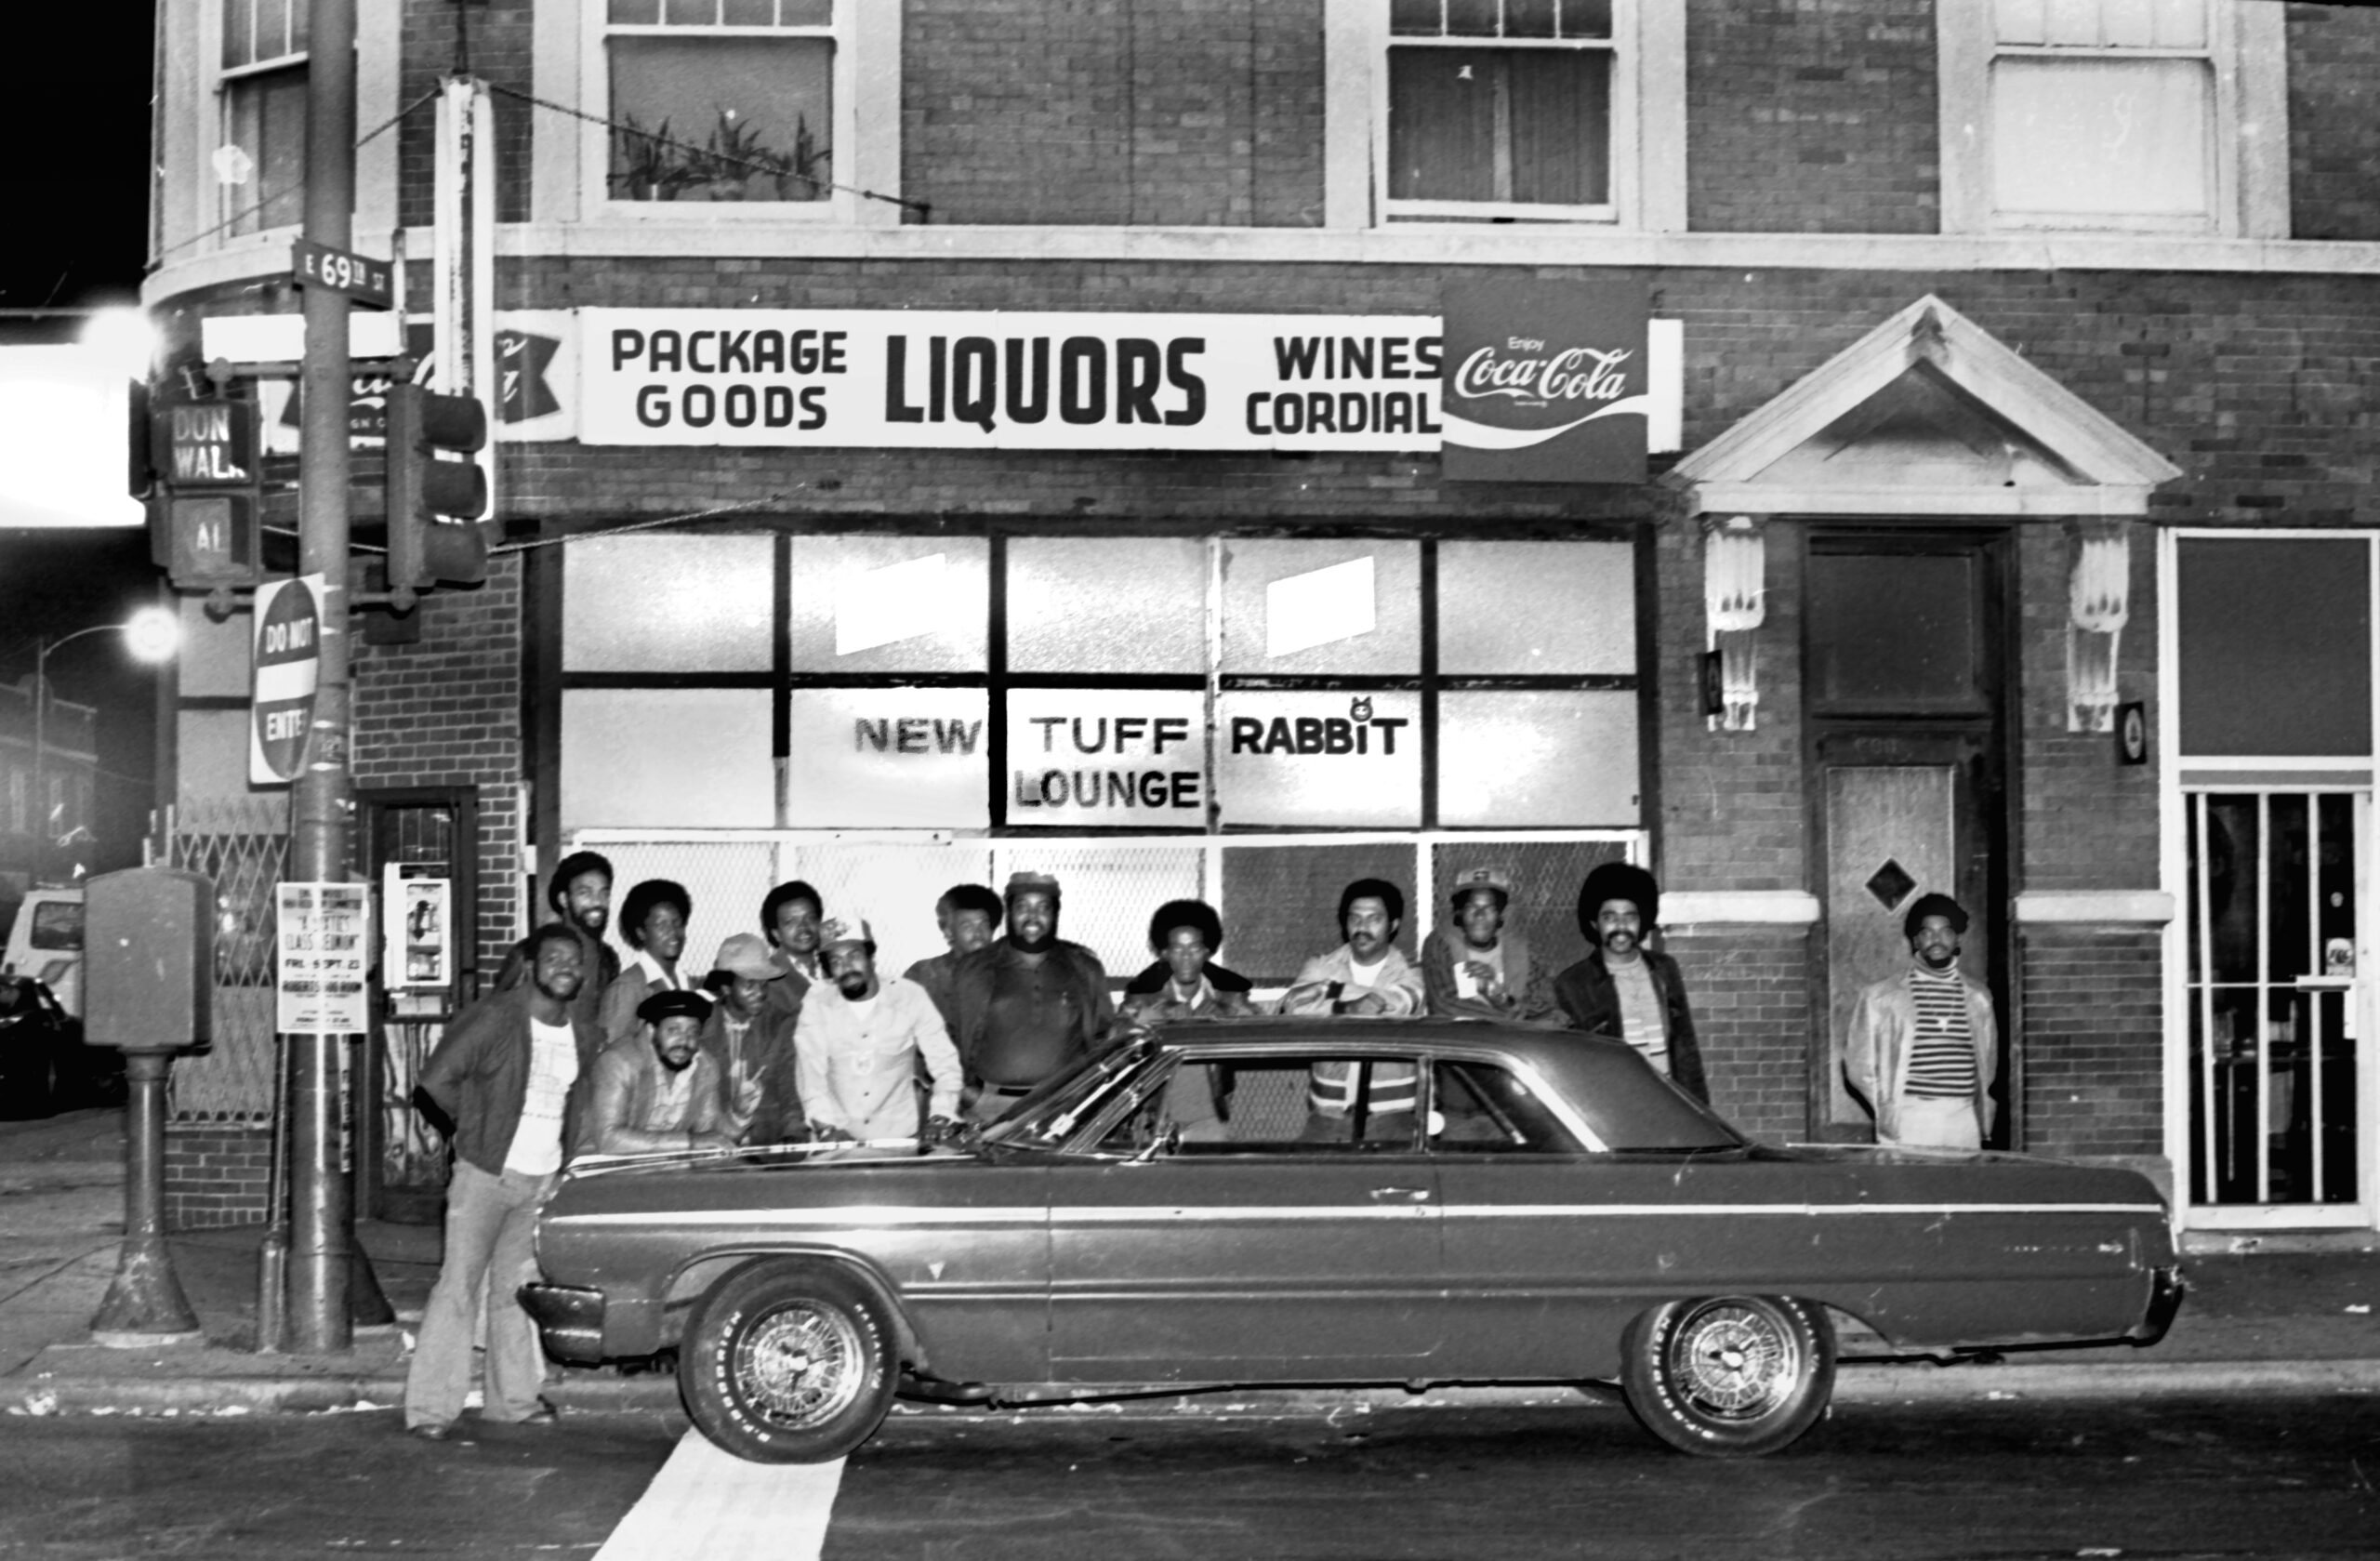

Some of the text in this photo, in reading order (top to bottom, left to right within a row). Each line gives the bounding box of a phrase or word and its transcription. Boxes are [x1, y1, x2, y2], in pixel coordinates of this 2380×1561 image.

[306, 254, 314, 274] E
[613, 330, 847, 374] PACKAGE
[1275, 337, 1441, 380] WINES
[1508, 337, 1544, 351] Enjoy
[886, 336, 1206, 433] LIQUORS
[1454, 346, 1634, 400] Coca-Cola
[173, 407, 230, 442] DON
[637, 385, 826, 430] GOODS
[266, 616, 313, 654] DO NOT
[855, 719, 982, 754] NEW
[1030, 717, 1188, 755] TUFF
[1016, 770, 1201, 809] LOUNGE
